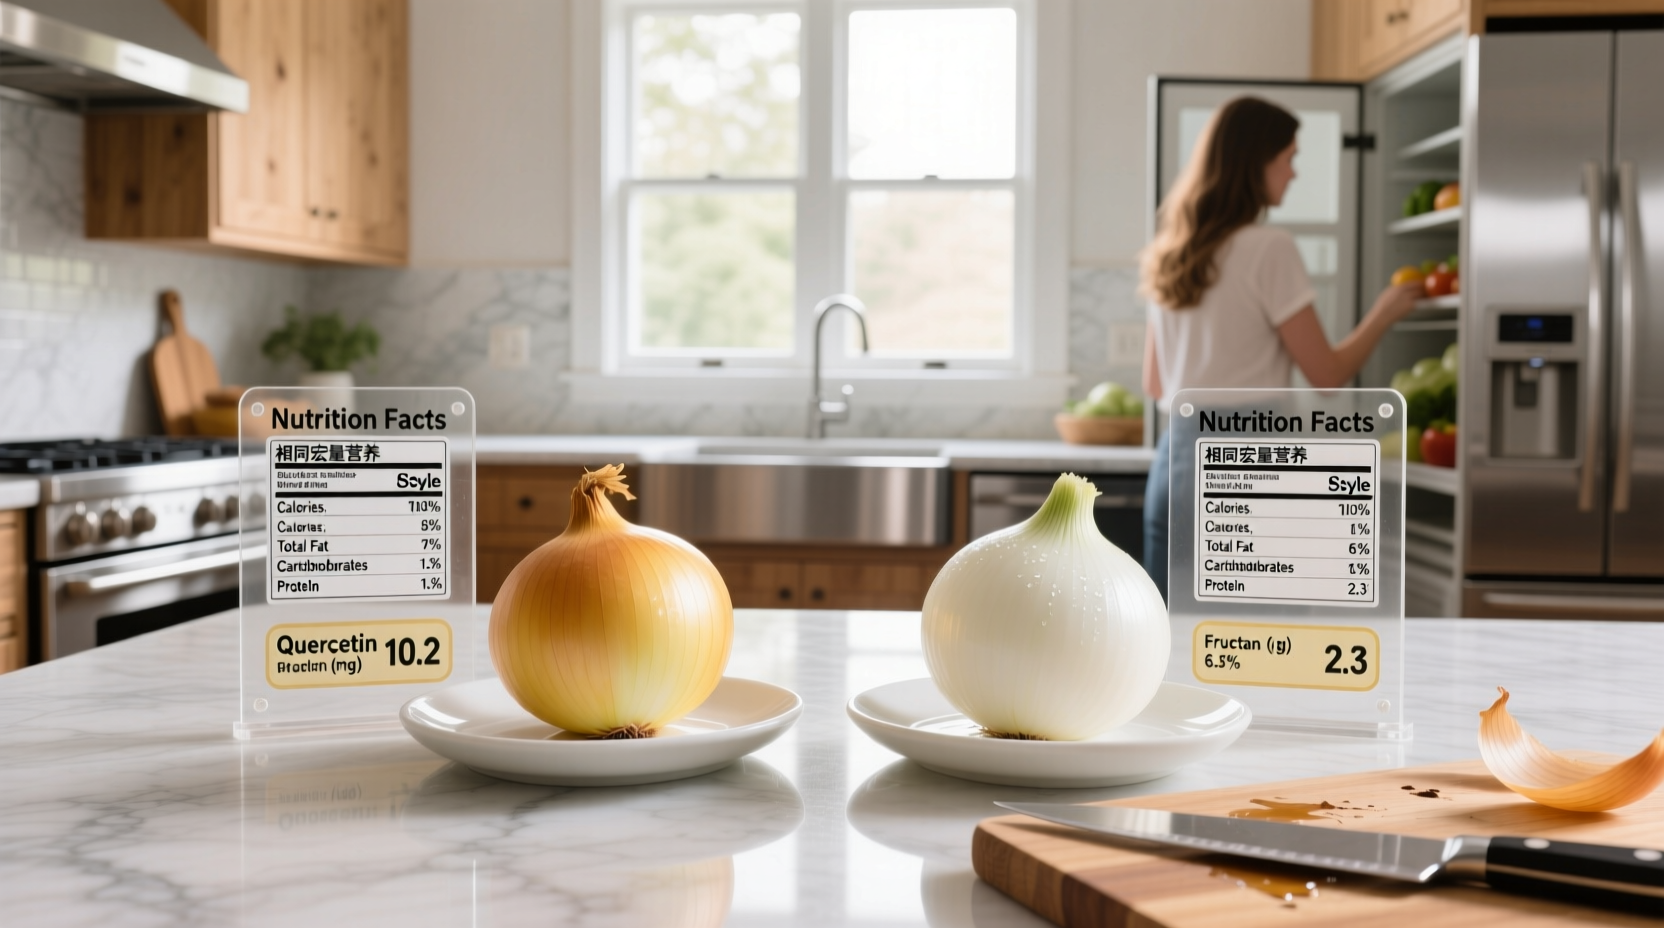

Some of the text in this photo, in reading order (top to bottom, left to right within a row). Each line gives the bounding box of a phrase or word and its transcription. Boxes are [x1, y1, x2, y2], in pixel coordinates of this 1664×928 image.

[272, 407, 446, 430] Nutrition Facts
[1199, 410, 1374, 432] Nutrition Facts
[275, 444, 381, 462] 相同宏量营养
[1205, 446, 1308, 464] 相同宏量营养
[277, 539, 441, 552] Total Fat 7%
[1205, 540, 1370, 555] Total Fat 6%
[277, 633, 440, 666] Quercetin 10.2
[1205, 634, 1261, 650] Fructan
[1324, 644, 1368, 675] 2.3
[331, 655, 362, 675] (mg)
[1204, 654, 1240, 670] 6.5%
